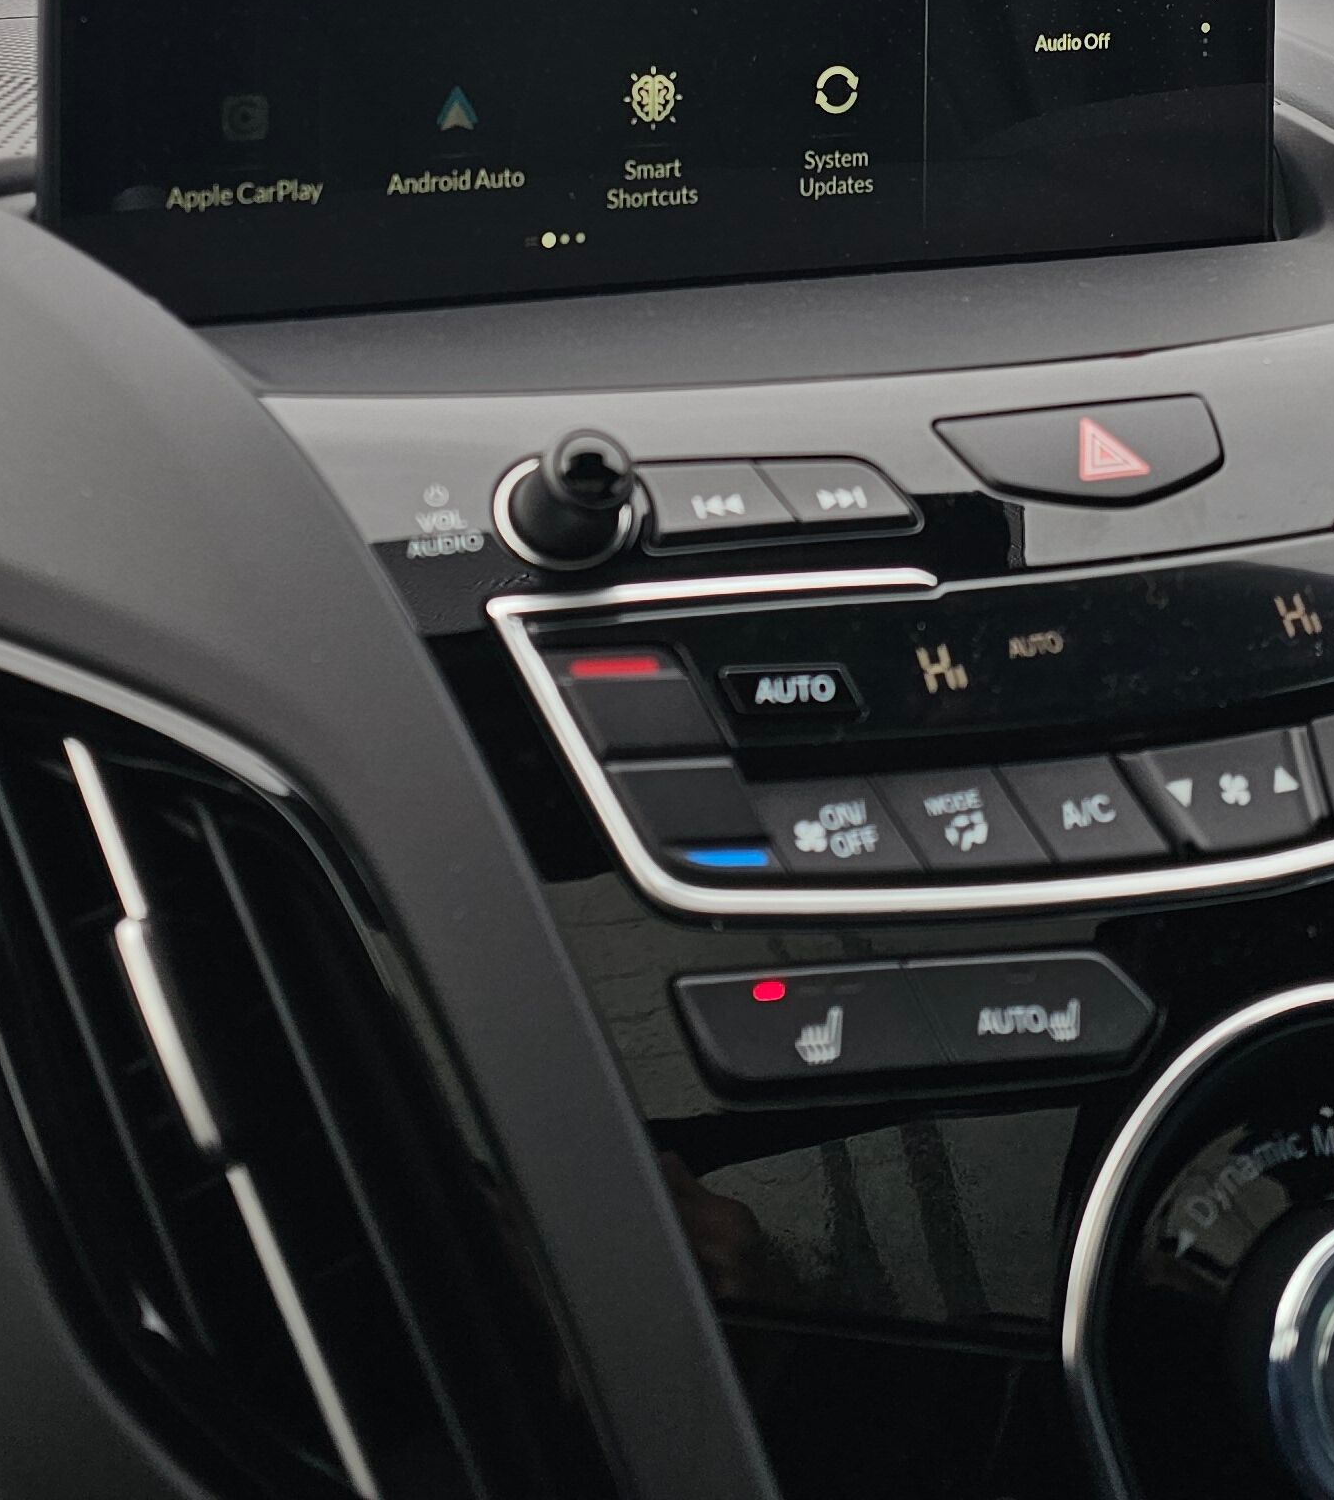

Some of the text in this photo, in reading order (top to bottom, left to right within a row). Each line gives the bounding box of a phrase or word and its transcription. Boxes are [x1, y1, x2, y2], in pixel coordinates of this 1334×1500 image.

[1034, 32, 1111, 52] Audio Off
[624, 158, 682, 182] Smart
[804, 149, 869, 173] System
[167, 179, 324, 211] Apple CarPlay
[387, 167, 526, 197] Android Auto
[799, 175, 875, 200] Updates
[606, 184, 699, 211] Shortcuts
[415, 508, 467, 533] VOL
[407, 529, 484, 558] AUDIO
[1009, 631, 1064, 659] AUTO
[754, 674, 836, 706] AUTO
[924, 789, 984, 817] MODE
[1062, 791, 1117, 831] A/C
[830, 825, 879, 859] OFF
[977, 1004, 1048, 1037] AUTO
